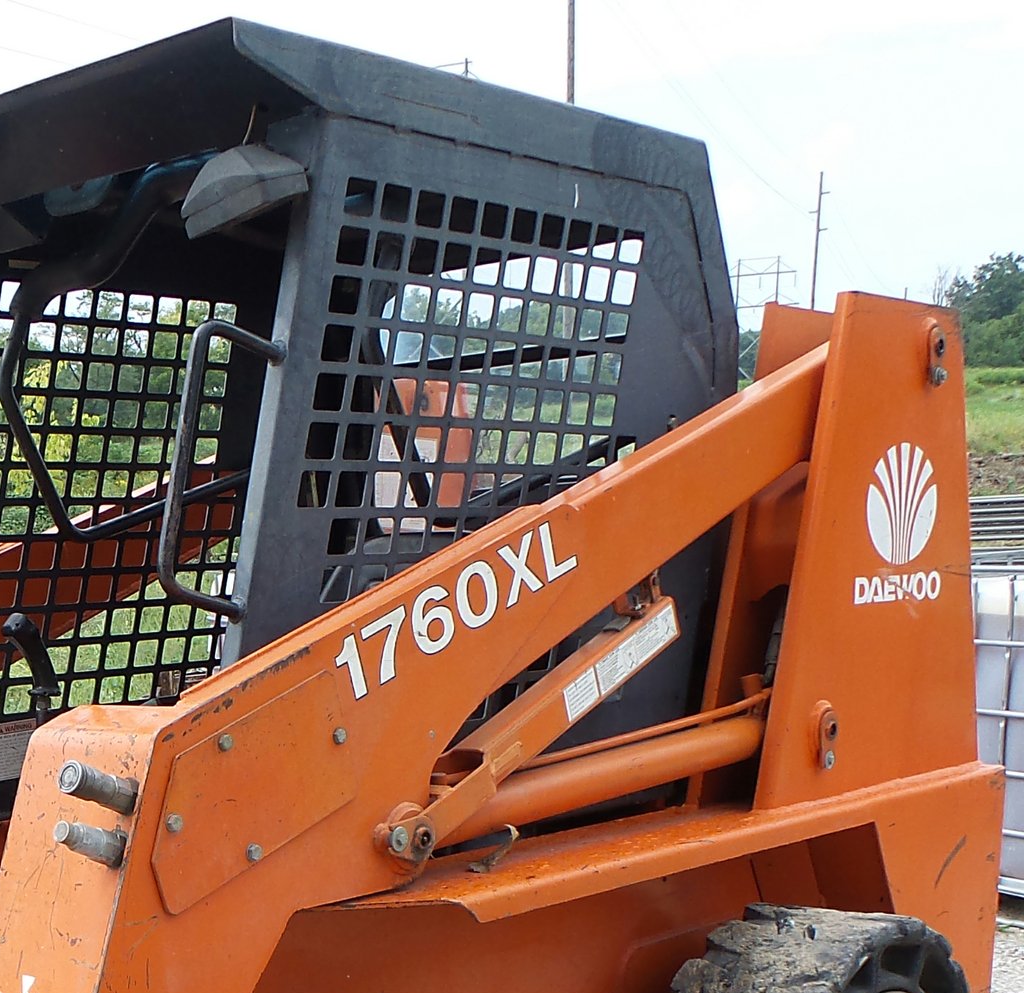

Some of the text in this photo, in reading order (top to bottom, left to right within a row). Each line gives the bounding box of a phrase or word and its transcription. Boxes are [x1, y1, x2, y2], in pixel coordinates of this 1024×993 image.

[854, 570, 942, 605] DAEWOO
[334, 520, 579, 701] 1760XL
[4, 723, 33, 734] WARNING
